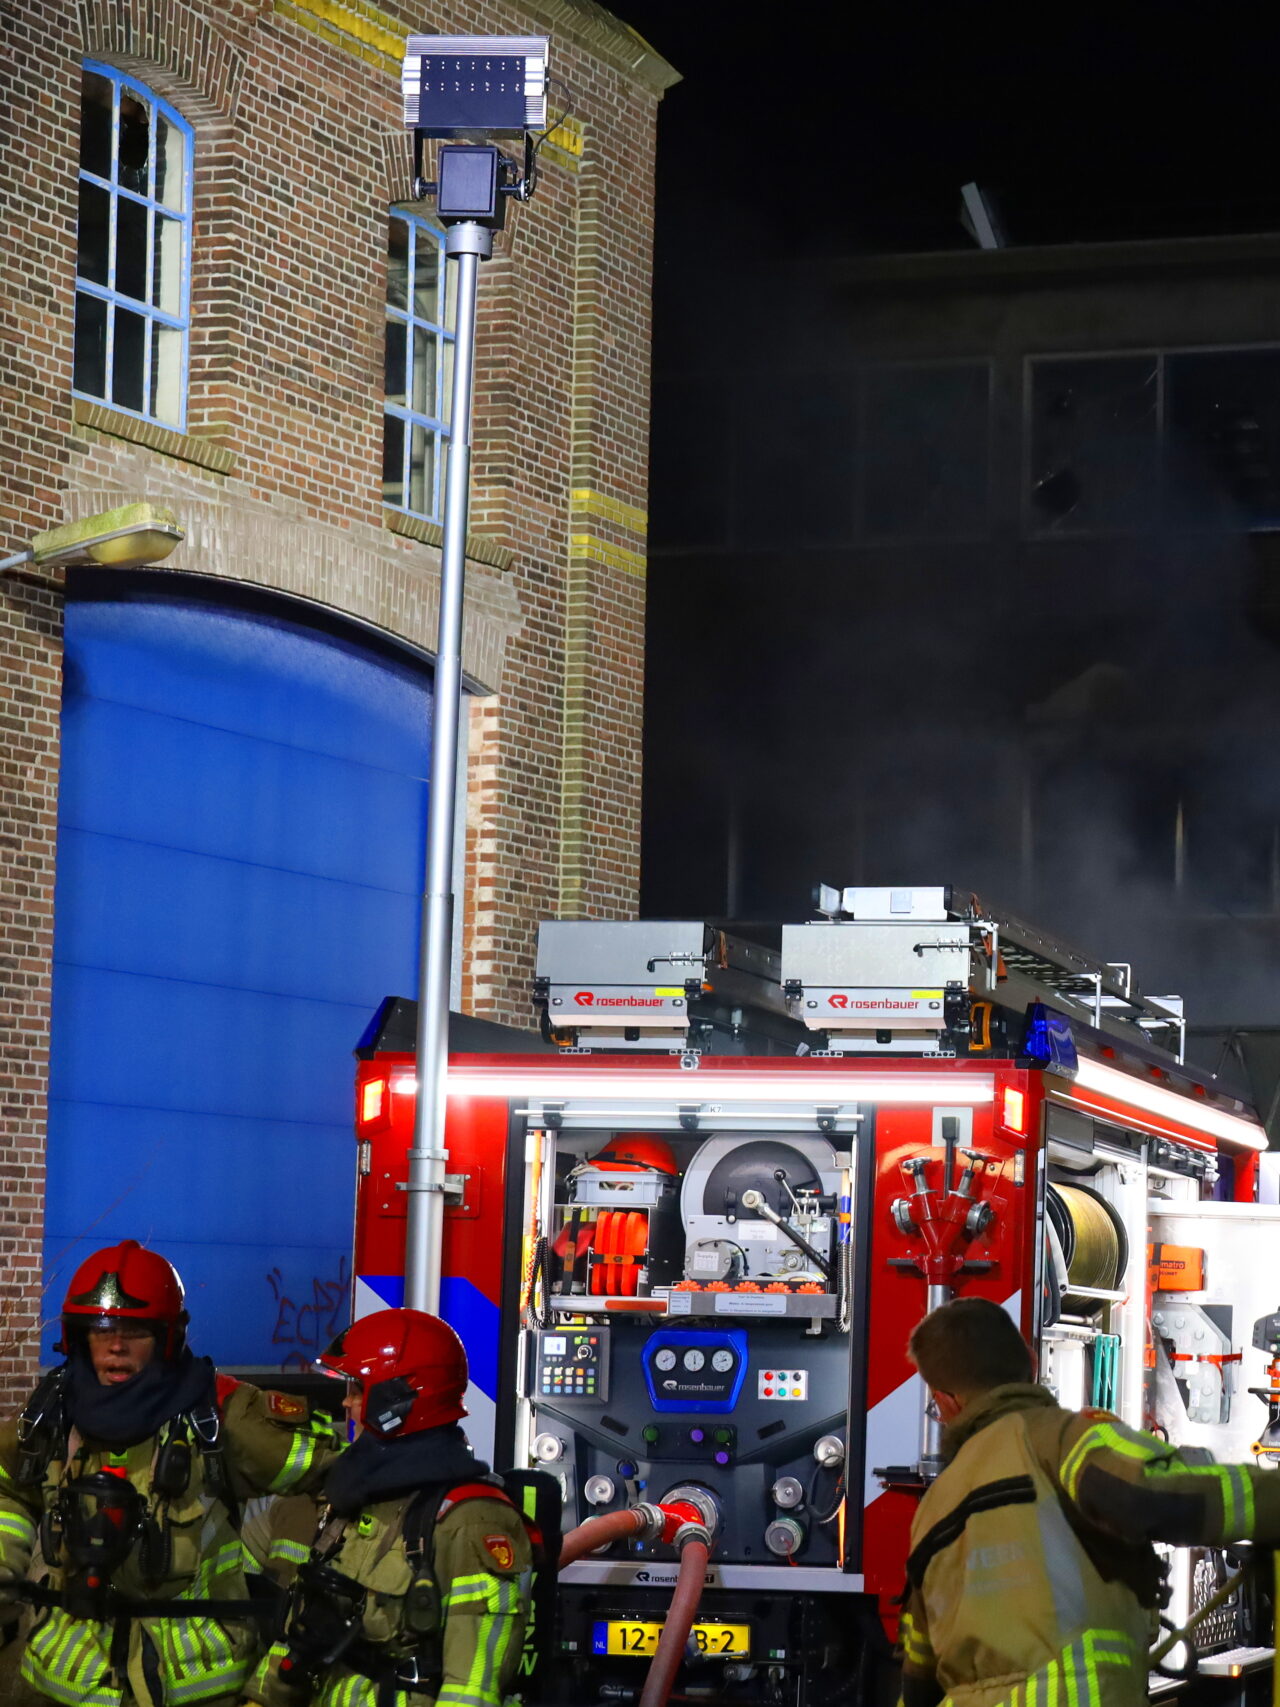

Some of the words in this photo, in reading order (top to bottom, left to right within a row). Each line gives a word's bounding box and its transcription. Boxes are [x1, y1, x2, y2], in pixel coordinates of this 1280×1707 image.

[596, 996, 664, 1007] rosenbauer
[850, 998, 920, 1009] rosenbauer
[678, 1383, 725, 1392] rosenbauer
[595, 1641, 606, 1649] NL
